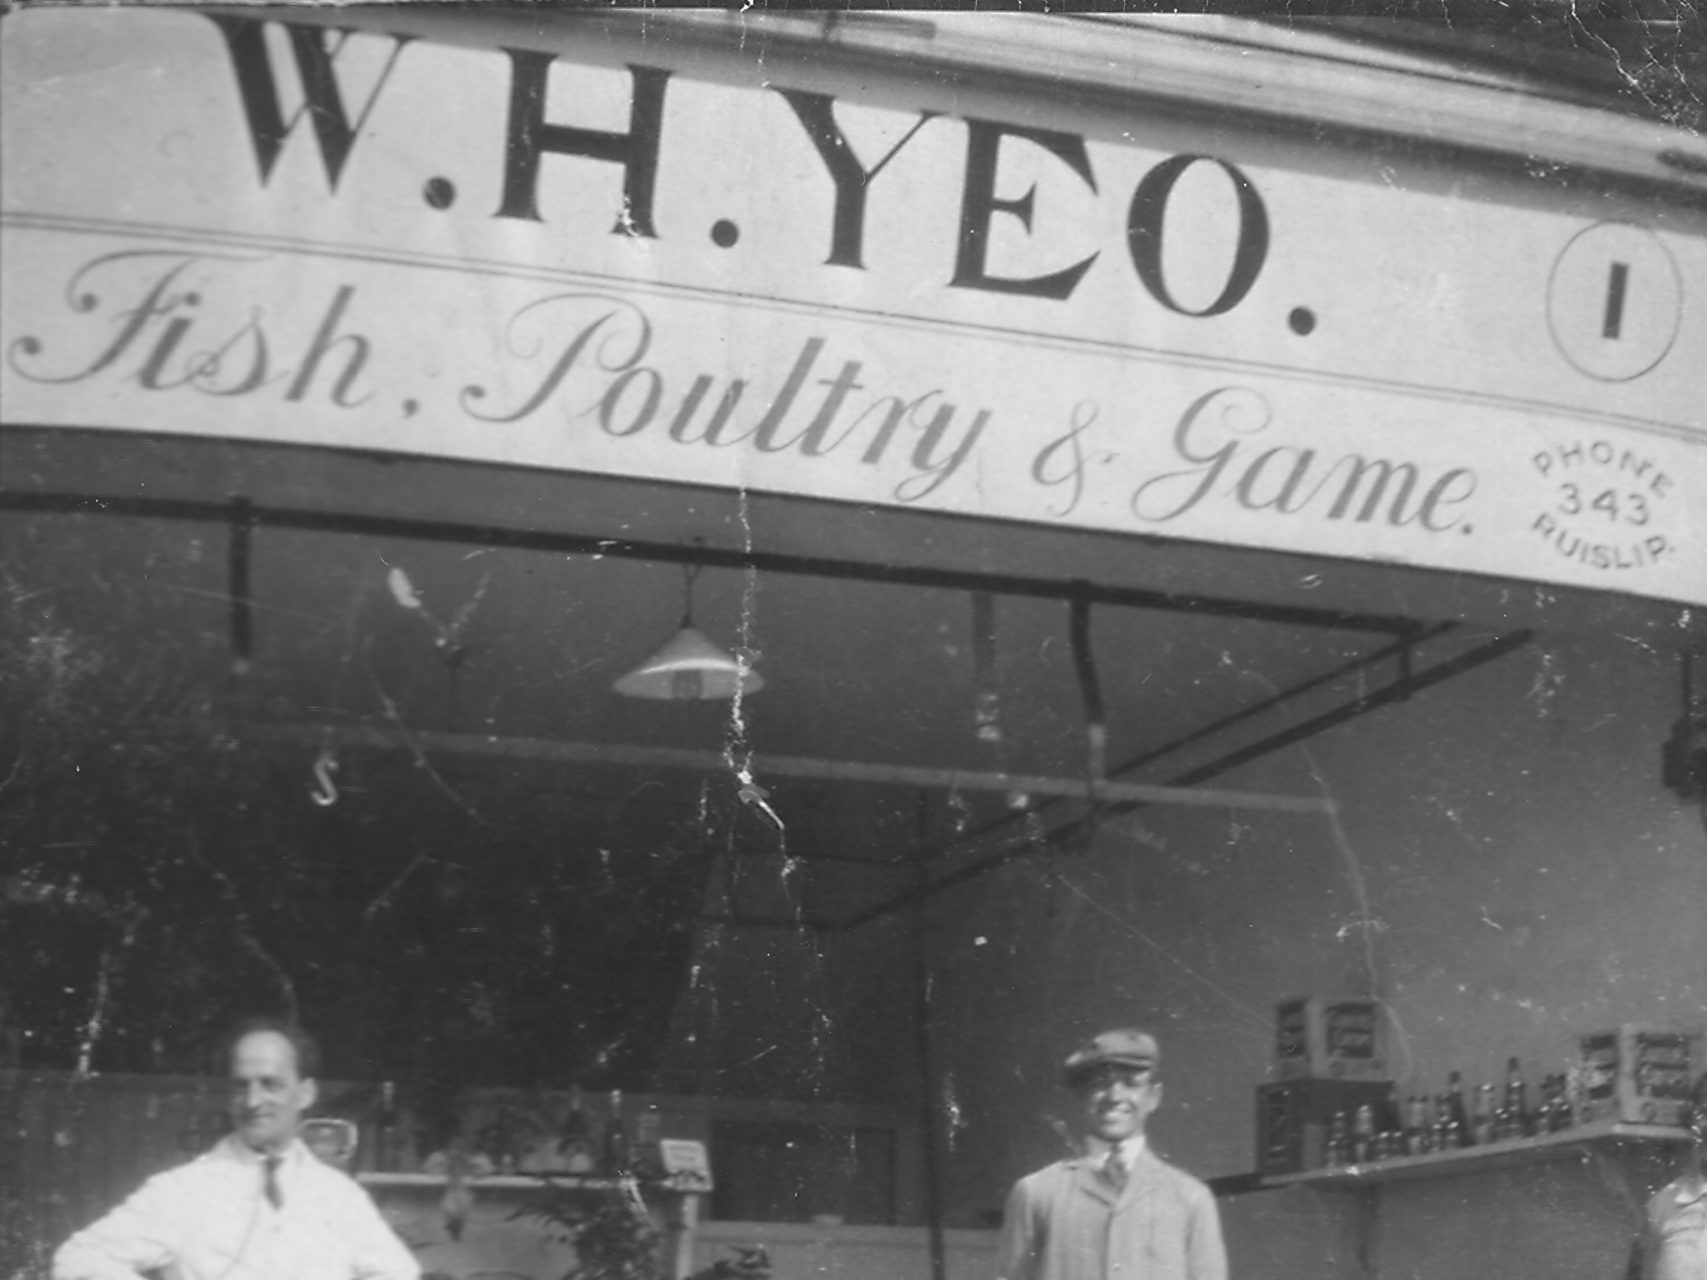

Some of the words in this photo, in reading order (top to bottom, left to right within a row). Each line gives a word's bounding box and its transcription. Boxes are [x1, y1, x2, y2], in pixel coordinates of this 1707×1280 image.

[8, 249, 419, 420] Fish,
[459, 292, 992, 503] Poultry
[1031, 401, 1113, 516] &
[1131, 385, 1479, 536] Game.
[1532, 440, 1674, 499] PHONE
[1558, 482, 1649, 526] 343
